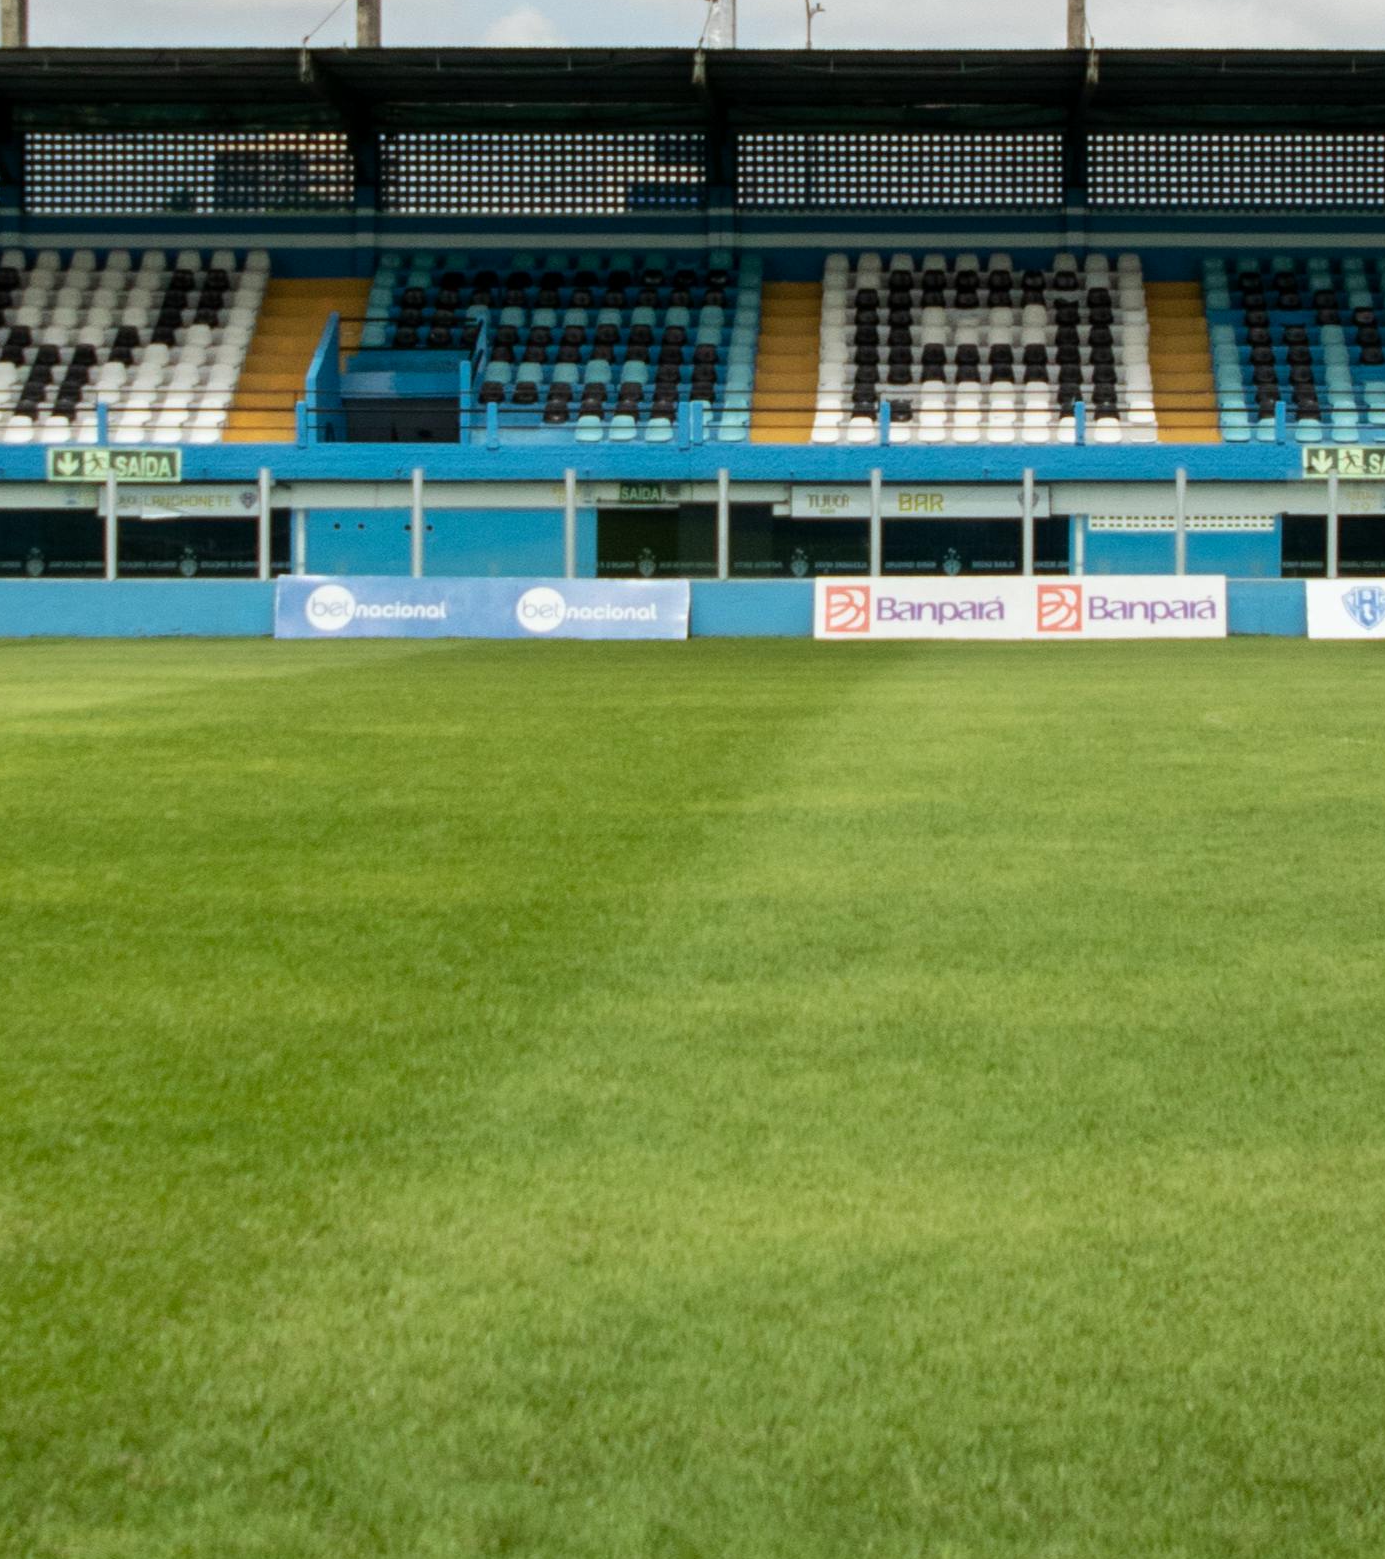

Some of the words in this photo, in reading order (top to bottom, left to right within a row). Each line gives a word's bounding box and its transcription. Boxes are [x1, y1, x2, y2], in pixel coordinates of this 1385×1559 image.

[115, 451, 172, 477] SAÍDA
[621, 484, 660, 500] SAÍDA
[898, 492, 944, 511] BAR
[876, 596, 1005, 625] Banpará
[1088, 595, 1216, 624] Banpará
